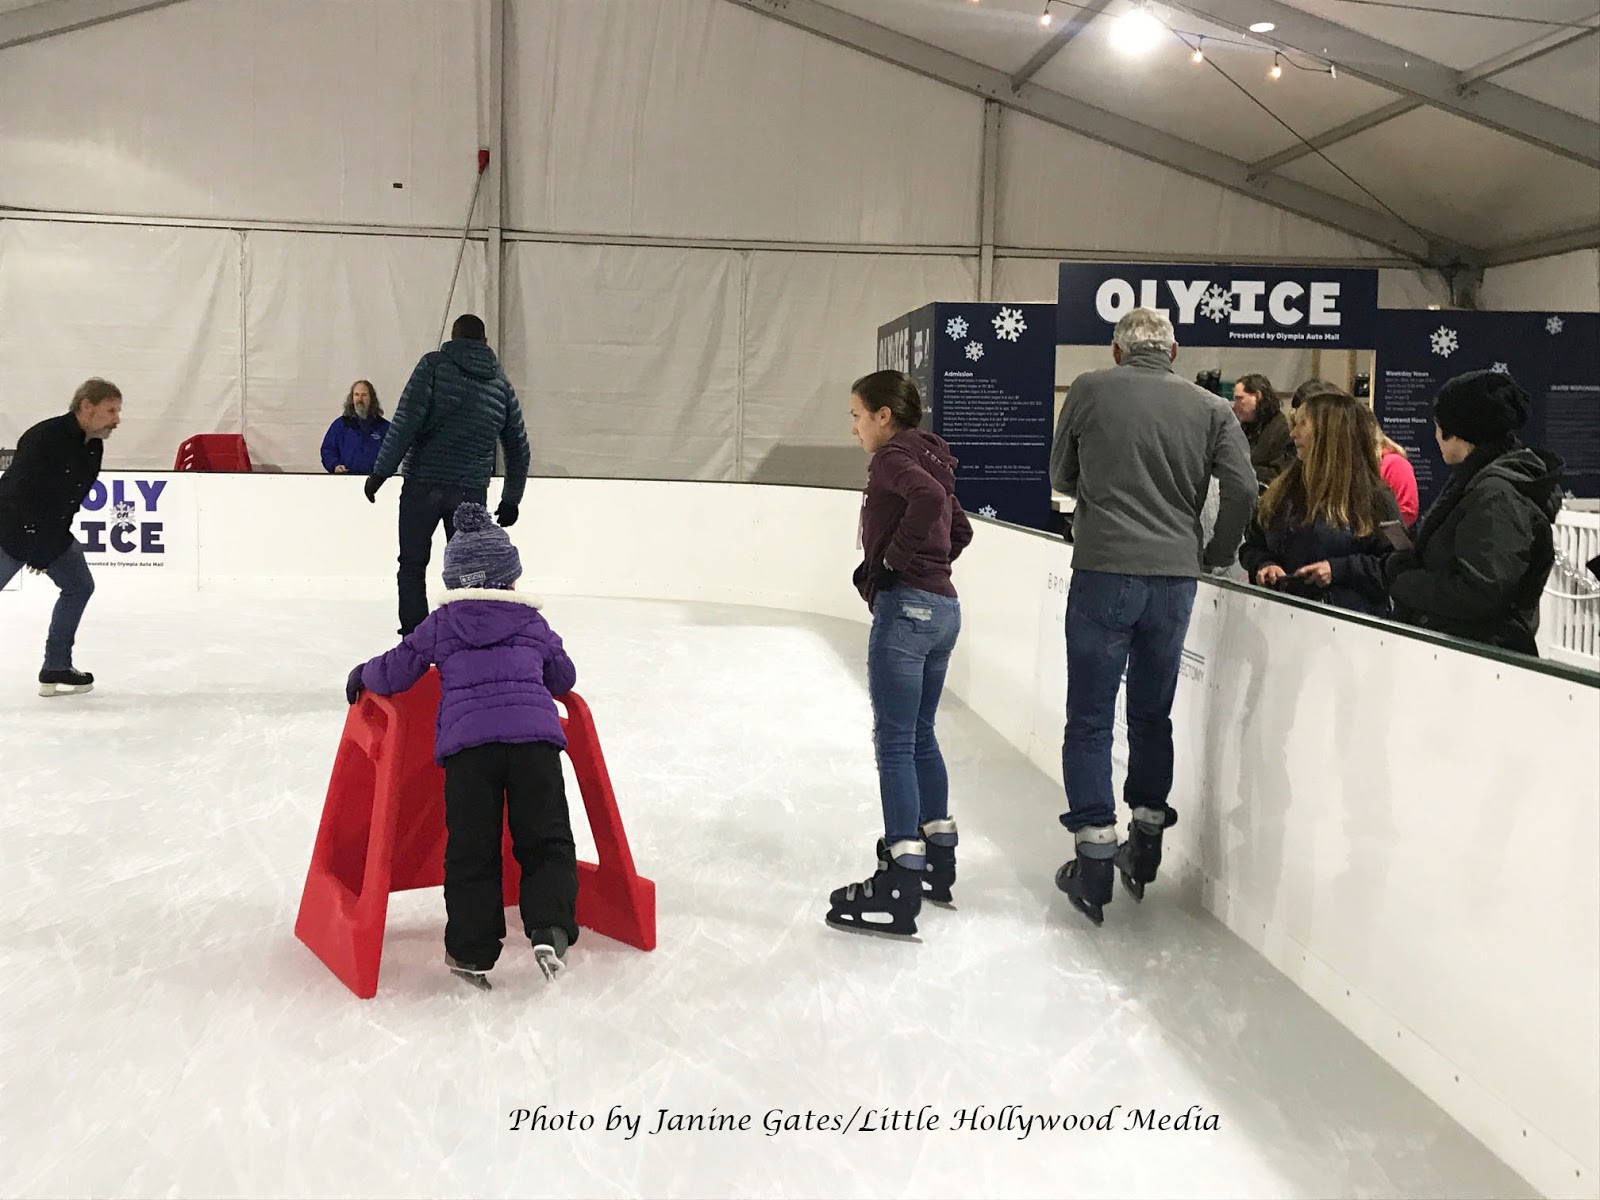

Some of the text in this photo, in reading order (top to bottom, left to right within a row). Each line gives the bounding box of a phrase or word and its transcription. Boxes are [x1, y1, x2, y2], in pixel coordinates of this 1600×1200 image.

[1095, 278, 1341, 326] OLY ICE
[1229, 331, 1265, 339] Presented
[1266, 332, 1275, 340] by
[1276, 332, 1304, 341] Olympia
[80, 479, 168, 512] OLY
[80, 521, 165, 553] ICE
